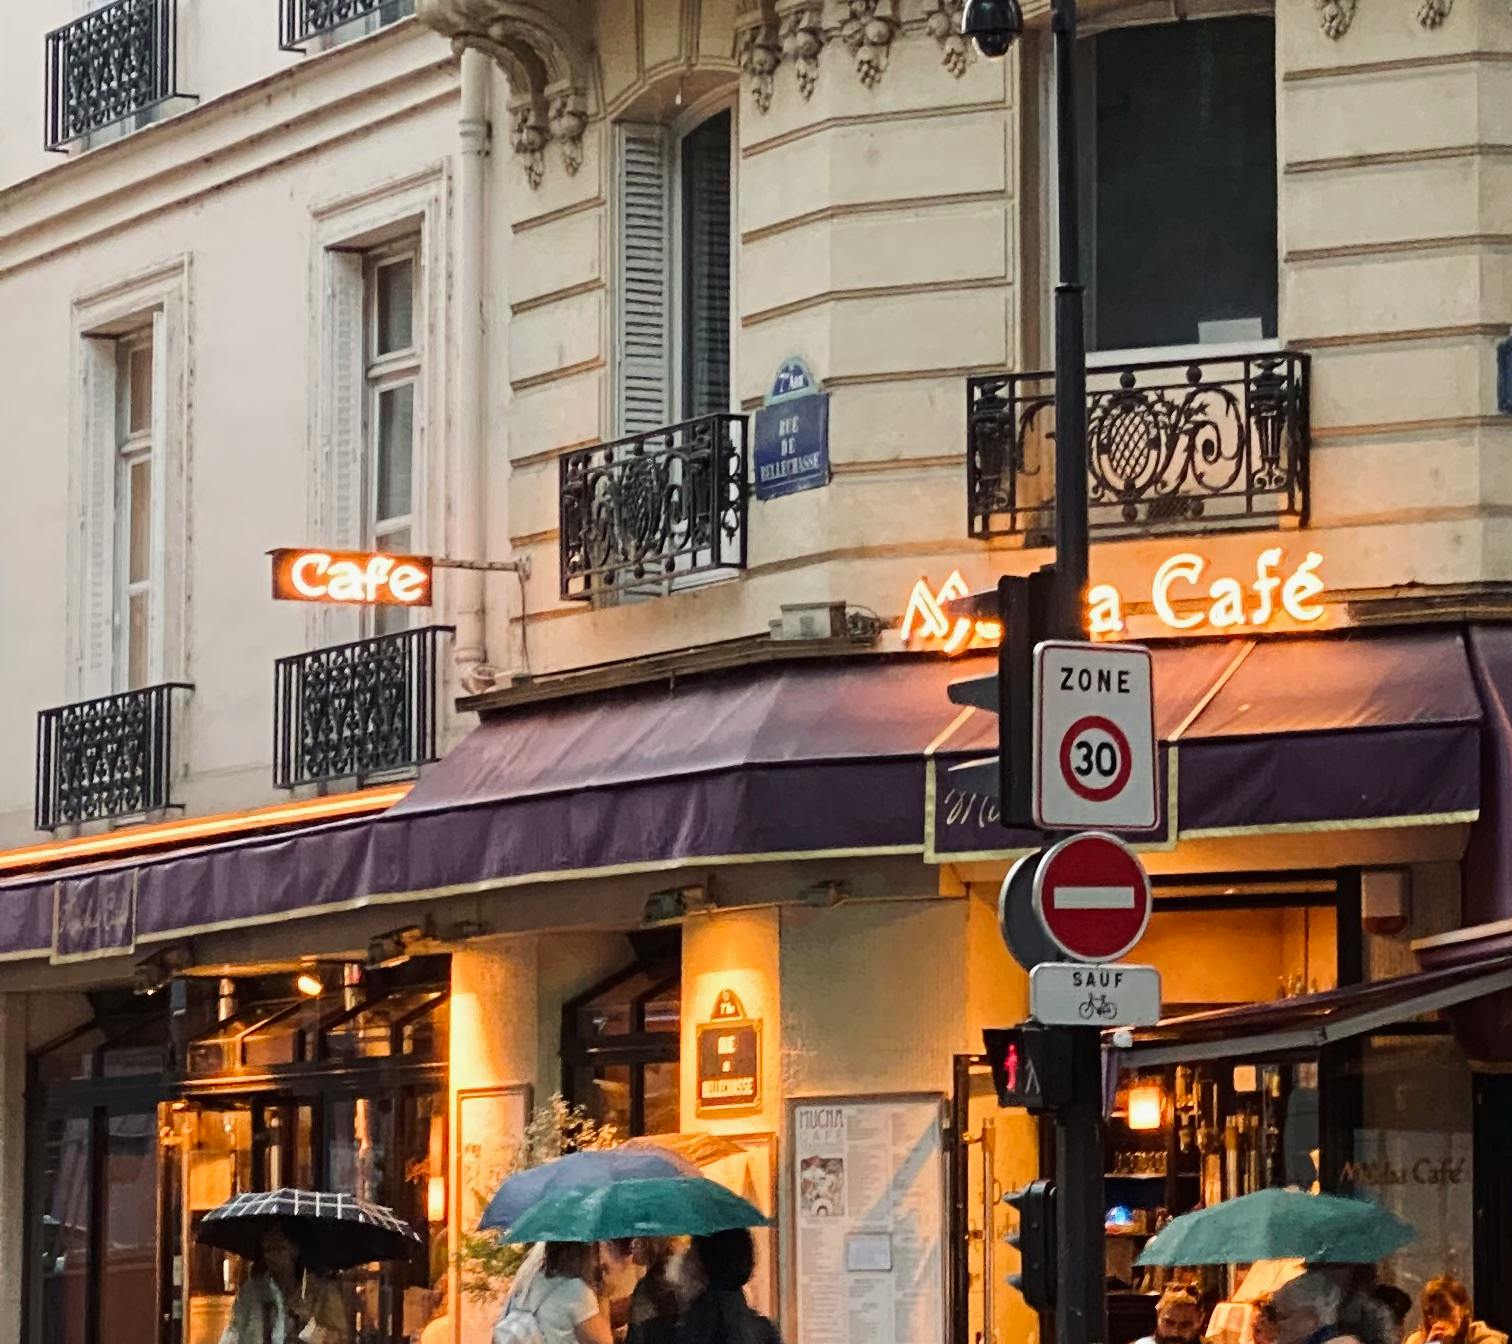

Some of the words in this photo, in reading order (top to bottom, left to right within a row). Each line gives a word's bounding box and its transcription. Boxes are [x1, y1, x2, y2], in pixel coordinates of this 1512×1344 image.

[779, 416, 799, 436] RUE
[781, 437, 796, 456] DE
[1152, 547, 1325, 628] Café
[1060, 667, 1130, 693] ZONE
[1075, 741, 1117, 777] 30
[1073, 971, 1123, 988] SAUF
